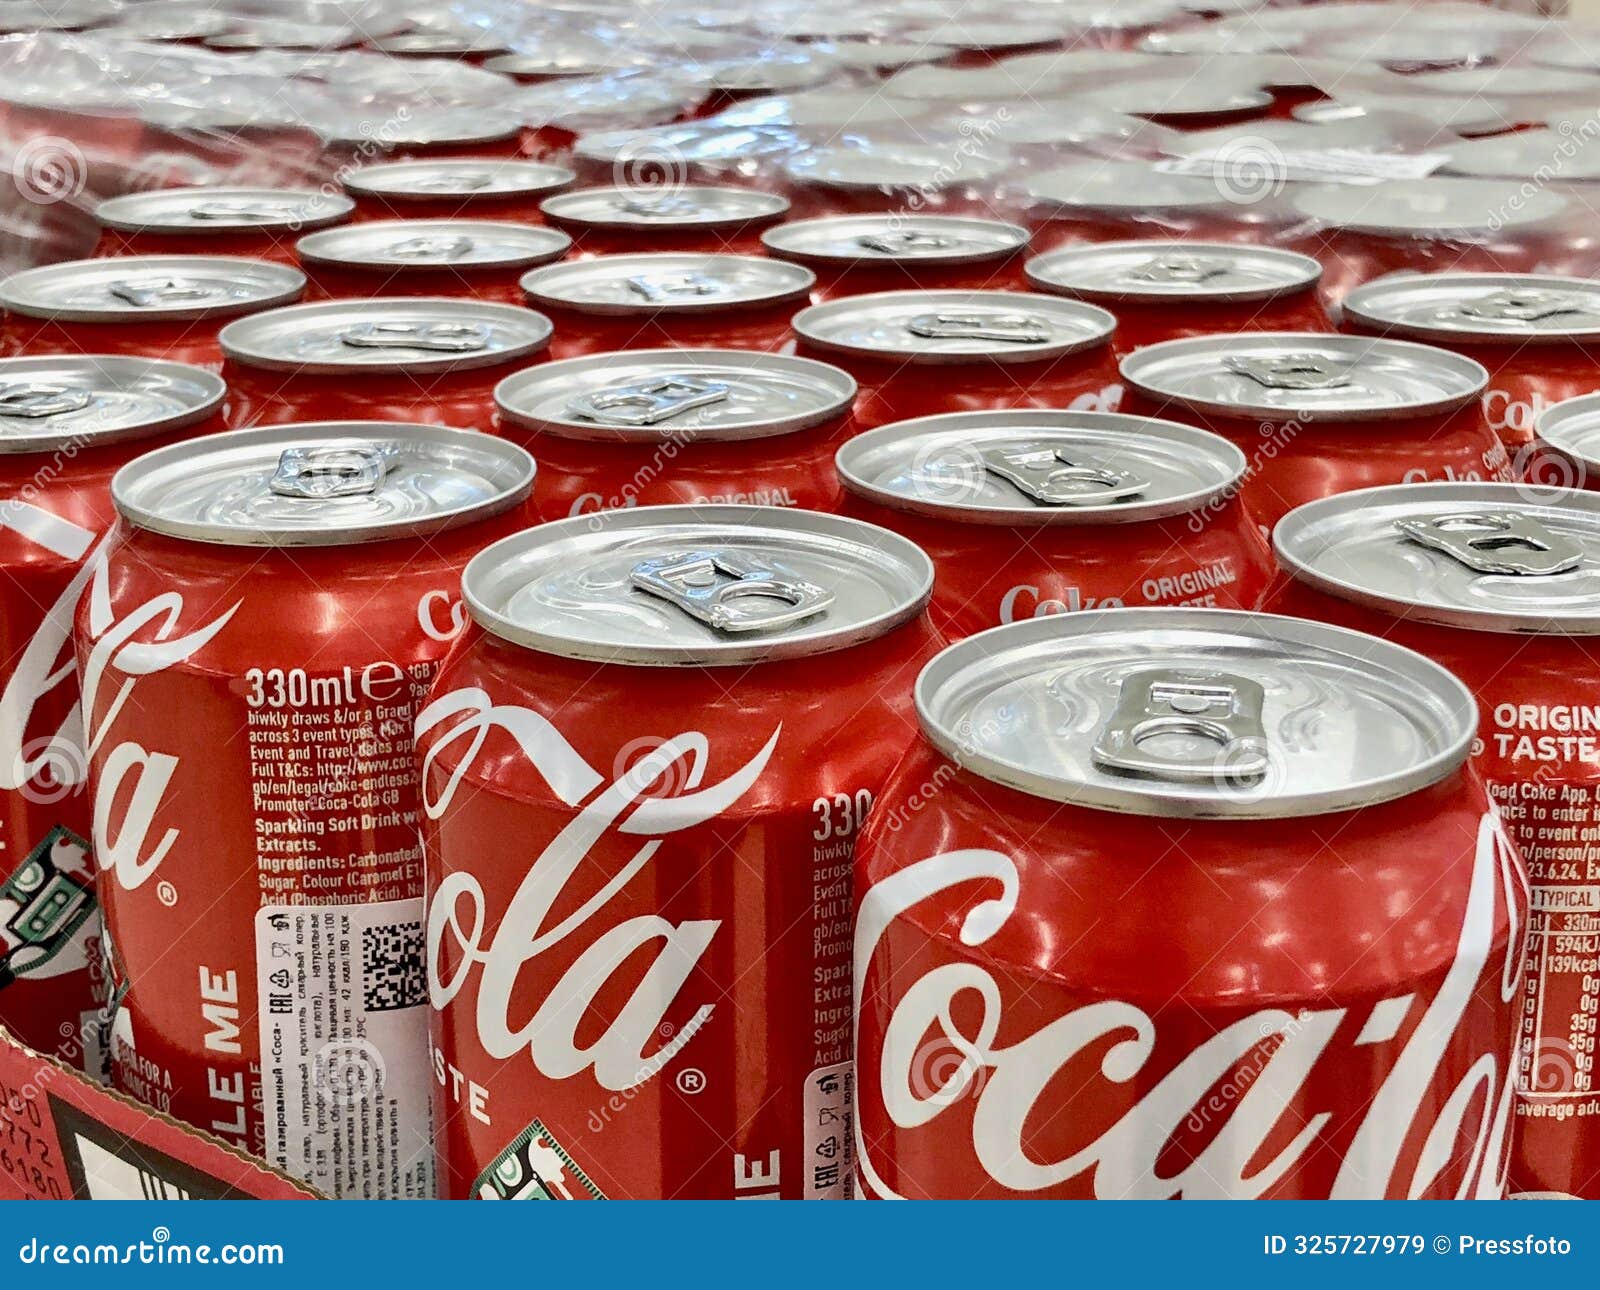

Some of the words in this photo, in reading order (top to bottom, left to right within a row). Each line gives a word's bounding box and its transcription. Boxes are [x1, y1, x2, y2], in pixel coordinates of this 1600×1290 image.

[1142, 563, 1236, 601] ORIGINAL
[246, 666, 357, 708] 330ml
[248, 710, 288, 727] biwkly
[292, 711, 330, 726] draws
[334, 708, 361, 725] &/or
[1494, 703, 1600, 731] ORIGIN
[249, 730, 289, 743] across
[292, 728, 299, 742] 3
[303, 729, 337, 743] event
[250, 745, 284, 761] Event
[288, 745, 310, 759] and
[315, 743, 353, 758] Travel
[1493, 733, 1597, 762] TASTE
[252, 762, 275, 777] Full
[277, 761, 314, 777] T&Cs:
[382, 790, 400, 805] GB
[1521, 782, 1556, 800] Coke
[255, 817, 325, 835] Sparkling
[328, 815, 358, 831] Soft
[361, 810, 400, 830] Drink
[1532, 805, 1546, 819] to
[1552, 808, 1589, 822] enter
[1538, 824, 1577, 841] event
[256, 836, 321, 852] Extracts.
[813, 841, 853, 863] biwkly
[257, 854, 346, 872] Ingredients:
[303, 873, 342, 888] Colour
[813, 881, 848, 901] Event
[1539, 889, 1593, 907] TYPICAL
[813, 901, 837, 920] Full
[325, 913, 335, 930] 100
[341, 989, 351, 1000] 42
[200, 965, 241, 1054] ME
[1570, 1013, 1597, 1033] 35g
[1568, 1033, 1595, 1054] 35g
[814, 1045, 842, 1065] Acid
[164, 1069, 172, 1090] A
[1517, 1101, 1574, 1121] average
